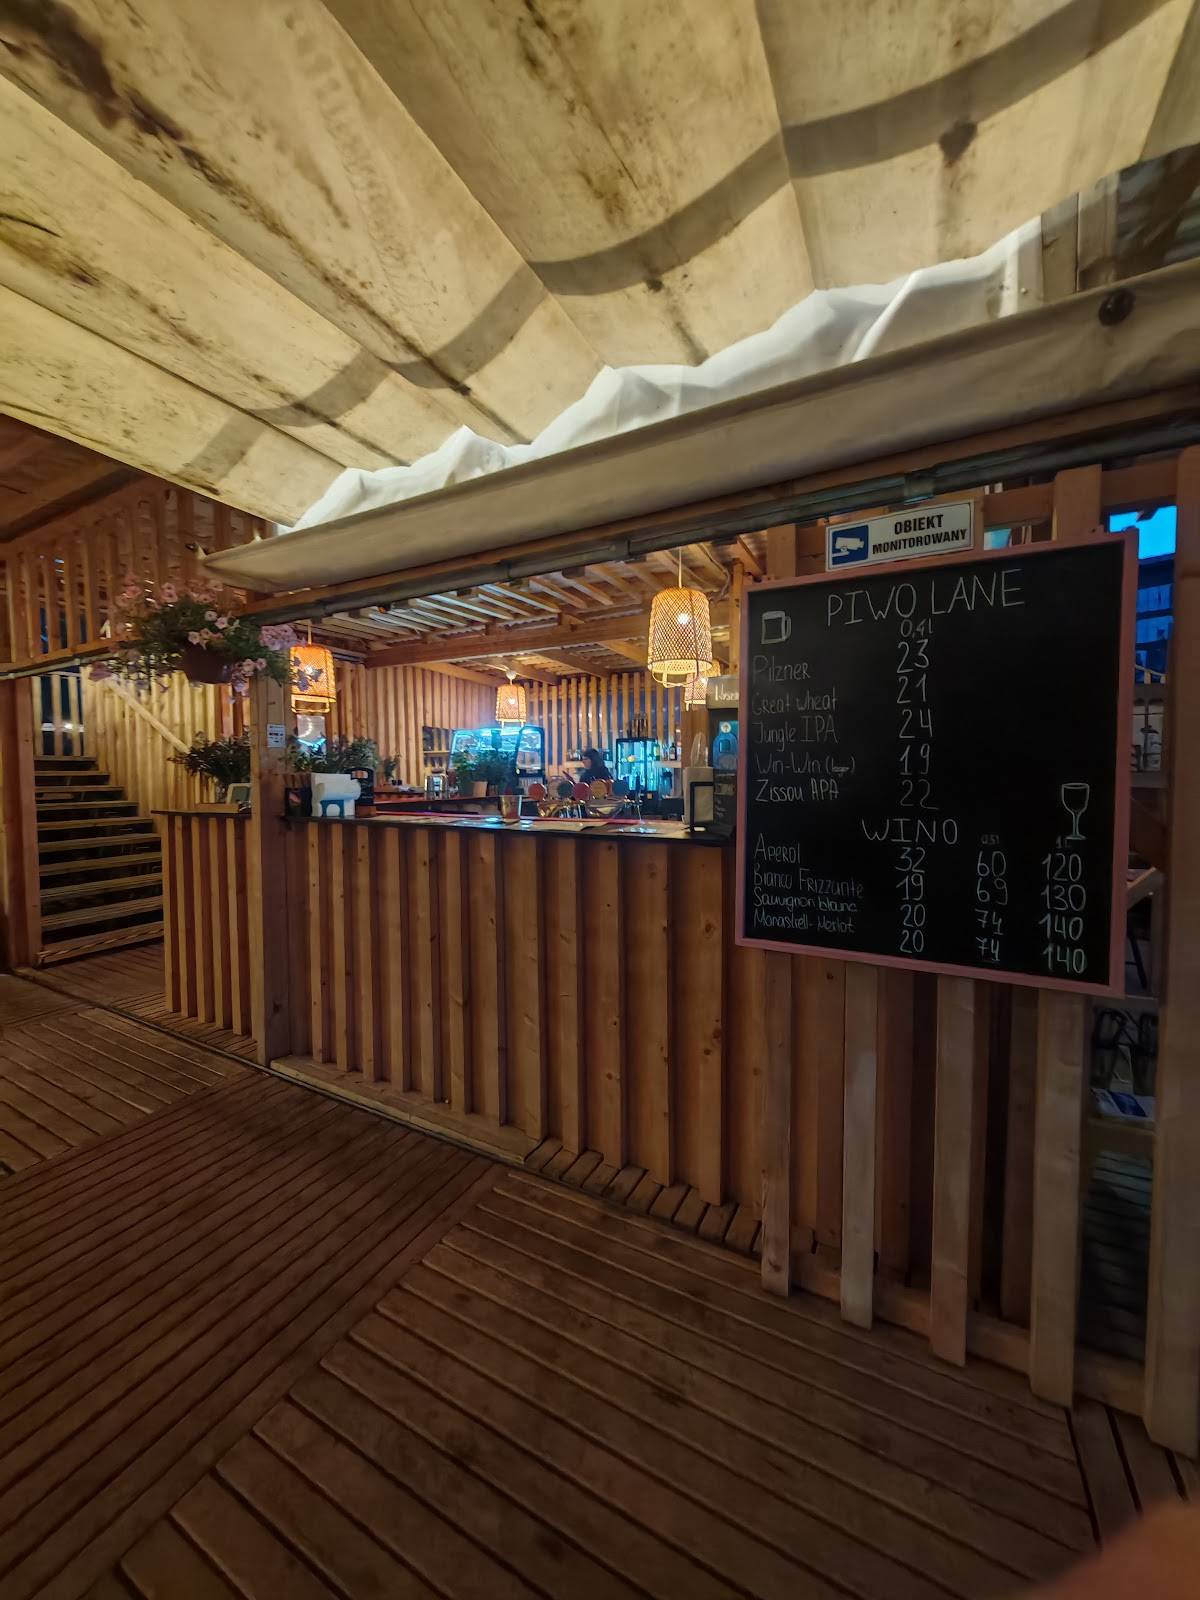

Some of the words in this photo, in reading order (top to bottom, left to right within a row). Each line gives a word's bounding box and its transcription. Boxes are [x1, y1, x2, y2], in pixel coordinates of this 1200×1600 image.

[894, 514, 944, 535] OBIEKT
[872, 528, 968, 555] MONITOROWANY
[827, 583, 917, 627] PIWO
[931, 568, 1025, 615] LANE
[752, 654, 811, 685] Pilzner
[896, 639, 930, 674] 23
[751, 692, 790, 716] Great
[896, 672, 927, 704] 21
[751, 720, 797, 752] Jungle
[799, 714, 840, 745] IPA
[899, 708, 934, 739] 24
[899, 743, 931, 775] 19
[754, 778, 805, 803] Zissou
[810, 777, 840, 802] APA
[899, 778, 940, 811] 22
[861, 818, 958, 845] WINO
[754, 832, 801, 865] Aperol
[895, 846, 927, 874] 32
[976, 850, 1007, 878] 60
[1041, 852, 1083, 882] 120
[895, 873, 925, 901] 19
[976, 877, 1009, 906] 69
[1040, 884, 1087, 912] 130
[899, 903, 927, 928] 20
[974, 907, 1004, 936] 74
[1038, 911, 1084, 942] 140
[899, 929, 925, 954] 20
[975, 935, 1000, 962] 74
[1042, 942, 1088, 975] 140
